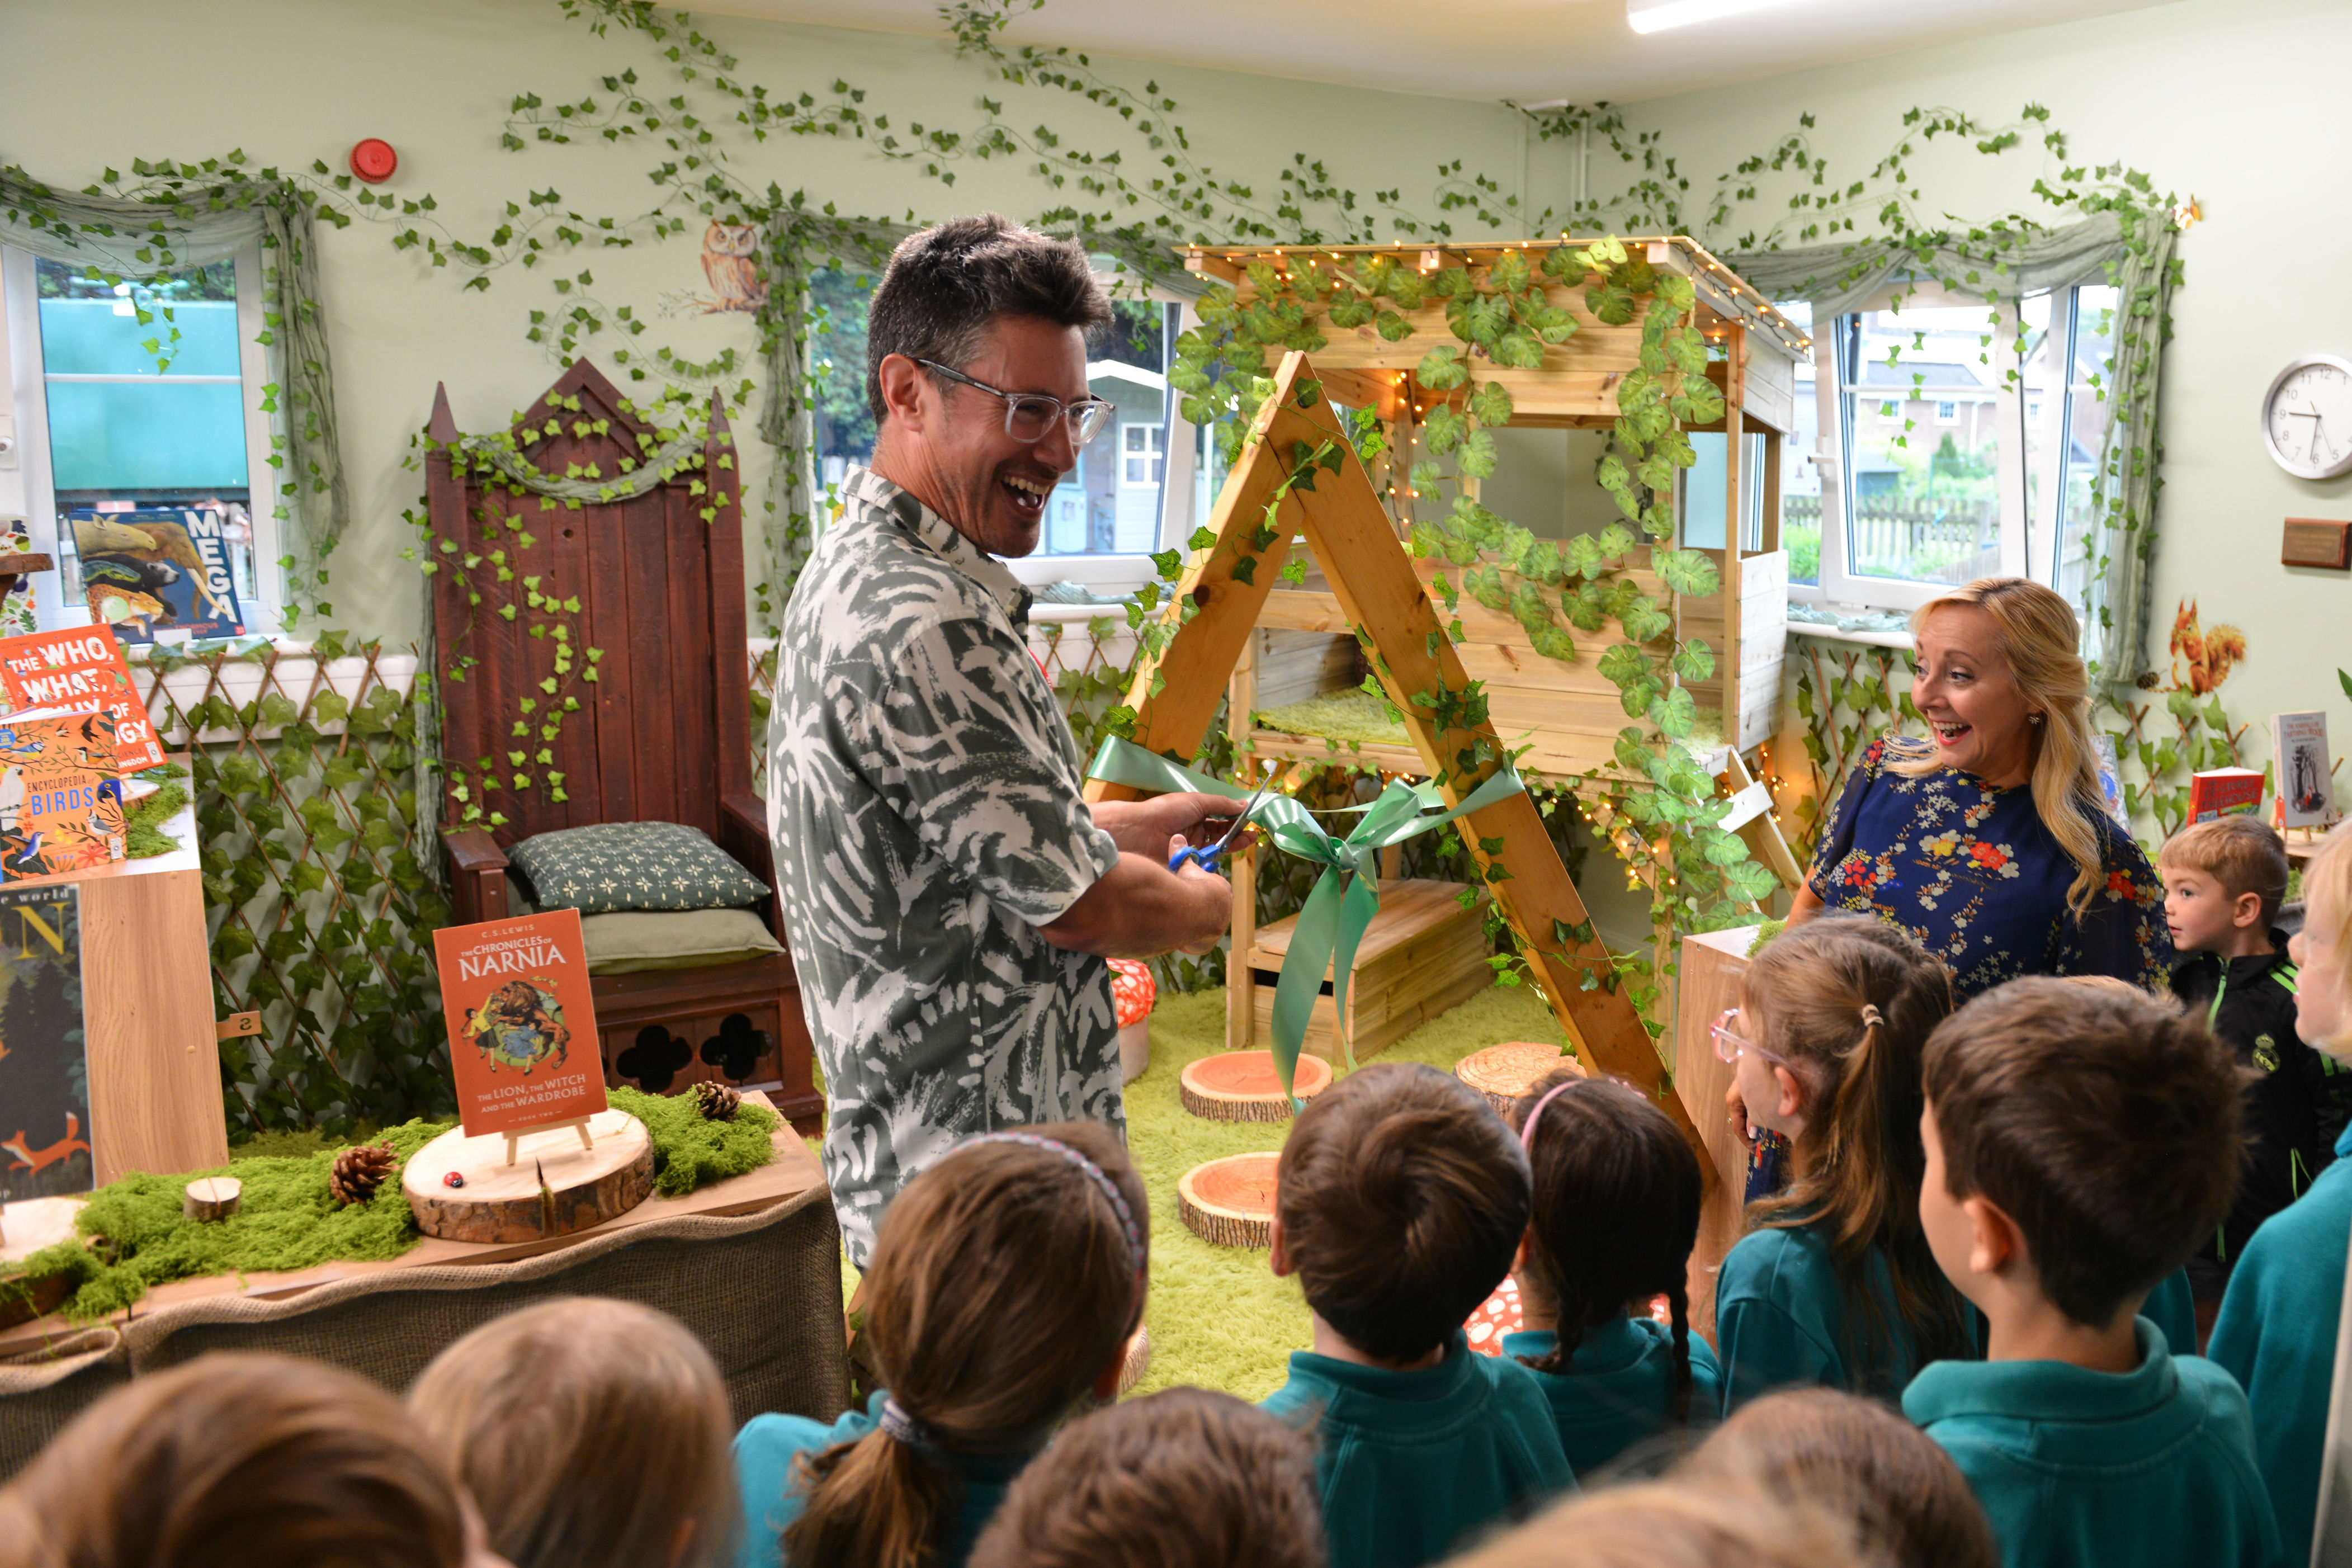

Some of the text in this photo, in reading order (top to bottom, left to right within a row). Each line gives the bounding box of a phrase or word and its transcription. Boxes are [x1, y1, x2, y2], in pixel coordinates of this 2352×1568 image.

[2302, 374, 2311, 385] 11
[2320, 368, 2331, 380] 12
[2287, 389, 2298, 400] 10
[2280, 409, 2286, 419] 9
[2283, 430, 2289, 441] 8
[2295, 446, 2301, 457] 7
[2312, 454, 2320, 464] 6
[2332, 449, 2339, 460] 5
[185, 511, 238, 623] MEGA
[8, 637, 114, 673] THE WHO,
[20, 668, 107, 703] WHAT,
[109, 702, 130, 719] OF
[118, 747, 143, 758] CIENCE
[118, 757, 148, 769] INGDOM
[28, 774, 86, 793] ENCYCLOPEDIA
[31, 787, 94, 816] BIRDS
[18, 888, 69, 902] world
[0, 902, 72, 960] N
[473, 936, 543, 956] CHRONICLES
[457, 944, 566, 981] NARNIA
[493, 1084, 528, 1099] LION,
[530, 1084, 544, 1092] THE
[545, 1074, 585, 1089] WITCH
[481, 1085, 585, 1113] AND THE WARDROBE
